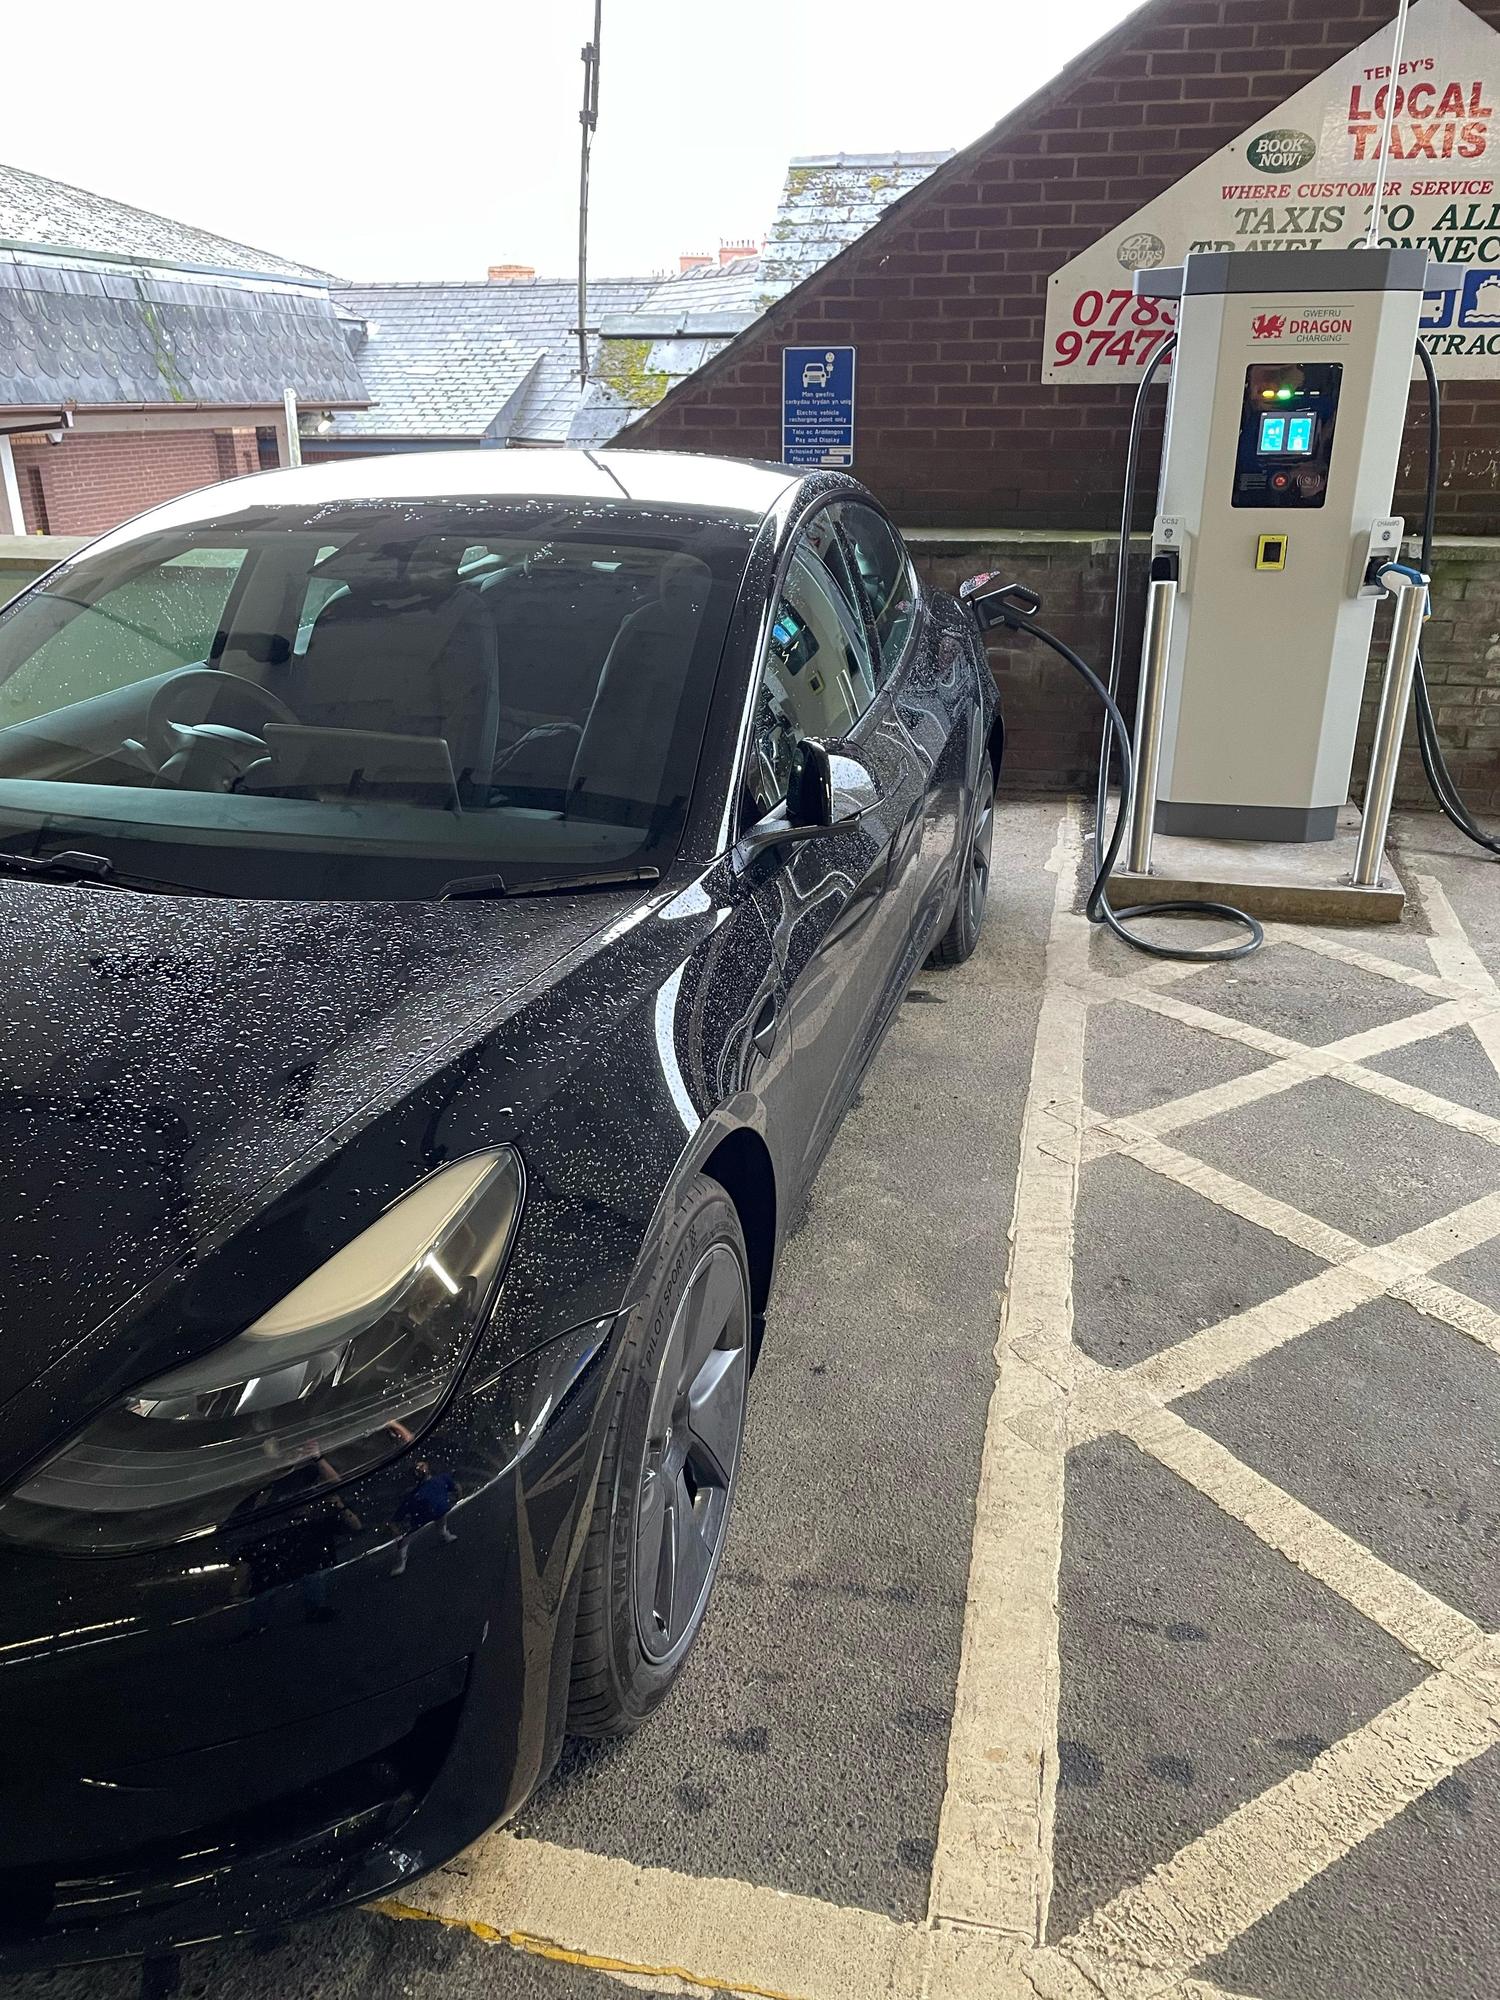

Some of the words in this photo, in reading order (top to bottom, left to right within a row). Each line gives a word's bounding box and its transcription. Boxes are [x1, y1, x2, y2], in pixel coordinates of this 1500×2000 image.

[1364, 58, 1434, 80] TENBY'S
[1347, 82, 1492, 120] LOCAL
[1256, 138, 1304, 153] BOOK
[1347, 122, 1487, 160] TAXIS
[1258, 152, 1302, 167] NOW!
[1222, 184, 1292, 200] WHERE
[1410, 180, 1494, 196] SERVICE
[1234, 205, 1346, 234] TAXIS
[1119, 248, 1163, 261] HOURS
[1303, 309, 1341, 318] GWEFRU
[1289, 320, 1347, 334] DRAGON
[646, 1309, 665, 1367] PILOT
[663, 1252, 685, 1306] SPORT
